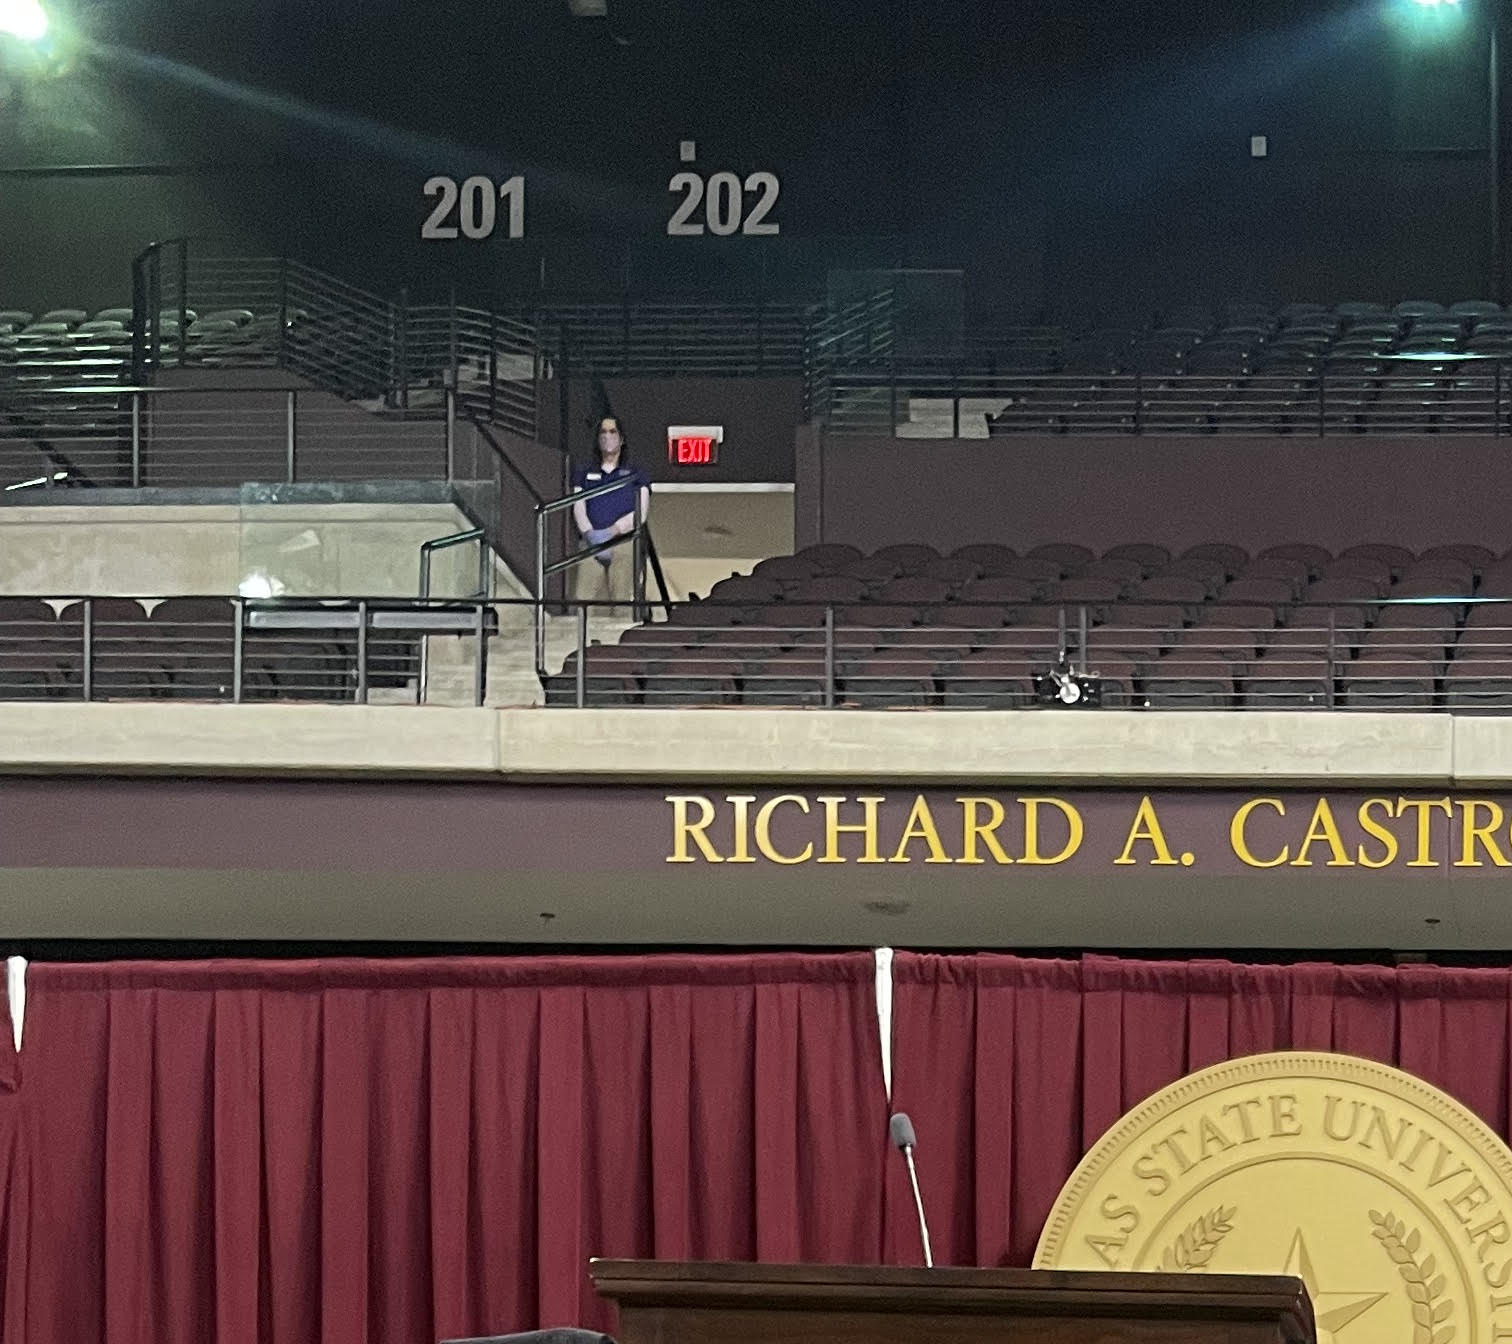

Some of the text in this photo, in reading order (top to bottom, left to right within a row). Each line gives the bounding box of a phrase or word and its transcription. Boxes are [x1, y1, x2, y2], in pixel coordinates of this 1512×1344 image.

[421, 175, 525, 239] 201
[667, 171, 780, 236] 202
[678, 438, 712, 463] EXIT
[664, 794, 1084, 864] RICHARD
[1113, 796, 1195, 866] A.
[1132, 1093, 1303, 1198] STATE
